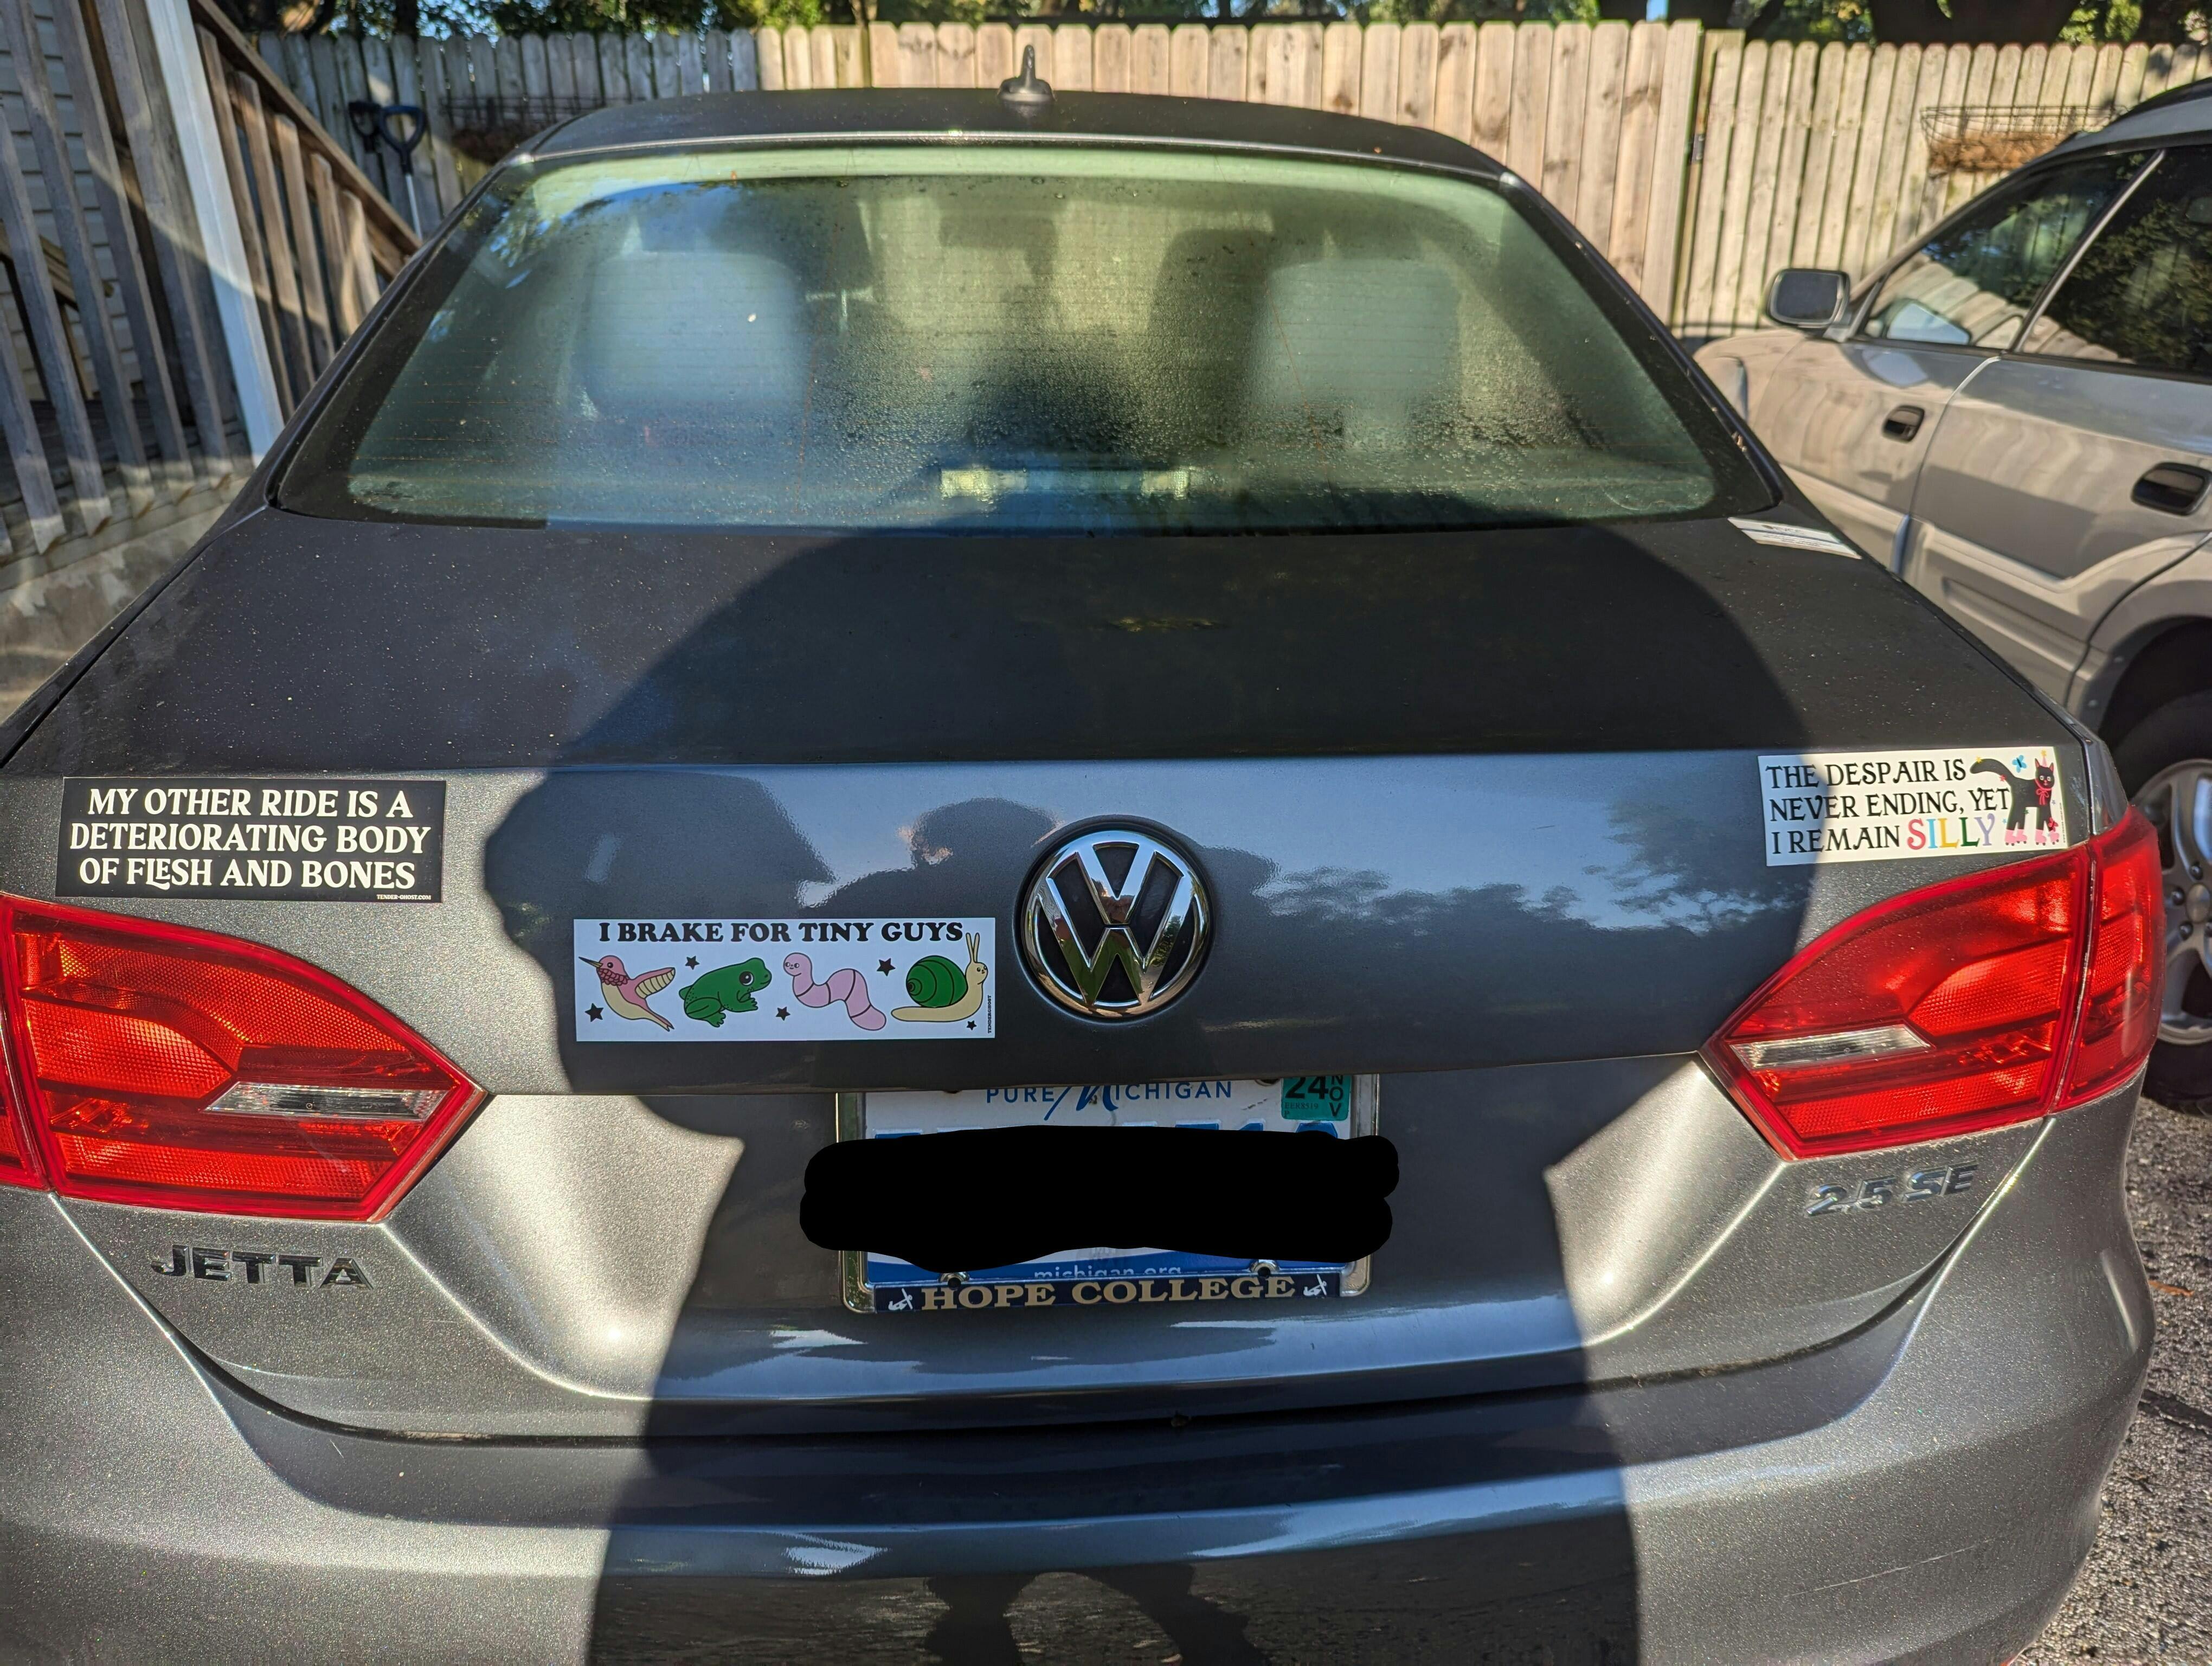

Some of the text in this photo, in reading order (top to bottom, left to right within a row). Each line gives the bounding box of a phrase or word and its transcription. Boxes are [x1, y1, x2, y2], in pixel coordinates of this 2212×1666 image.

[1765, 759, 1966, 789] THE DESPAIR IS
[88, 788, 414, 818] MY OTHER RIDE IS A
[1770, 787, 2009, 822] NEVER ENDING, YET
[69, 823, 432, 854] DETERIORATING BODY
[1772, 813, 1995, 854] I REMAIN SILLY
[79, 857, 416, 890] OF FLESH AND BONES
[599, 922, 963, 943] I BRAKE FOR TINY GUYS
[986, 1081, 1232, 1121] PURE MICHIGAN
[1285, 1076, 1328, 1099] 24
[1901, 1161, 1979, 1203] SE
[150, 1244, 375, 1290] JETTA
[1034, 1265, 1181, 1278] michianor
[921, 1276, 1296, 1310] HOPE COLLEGE
